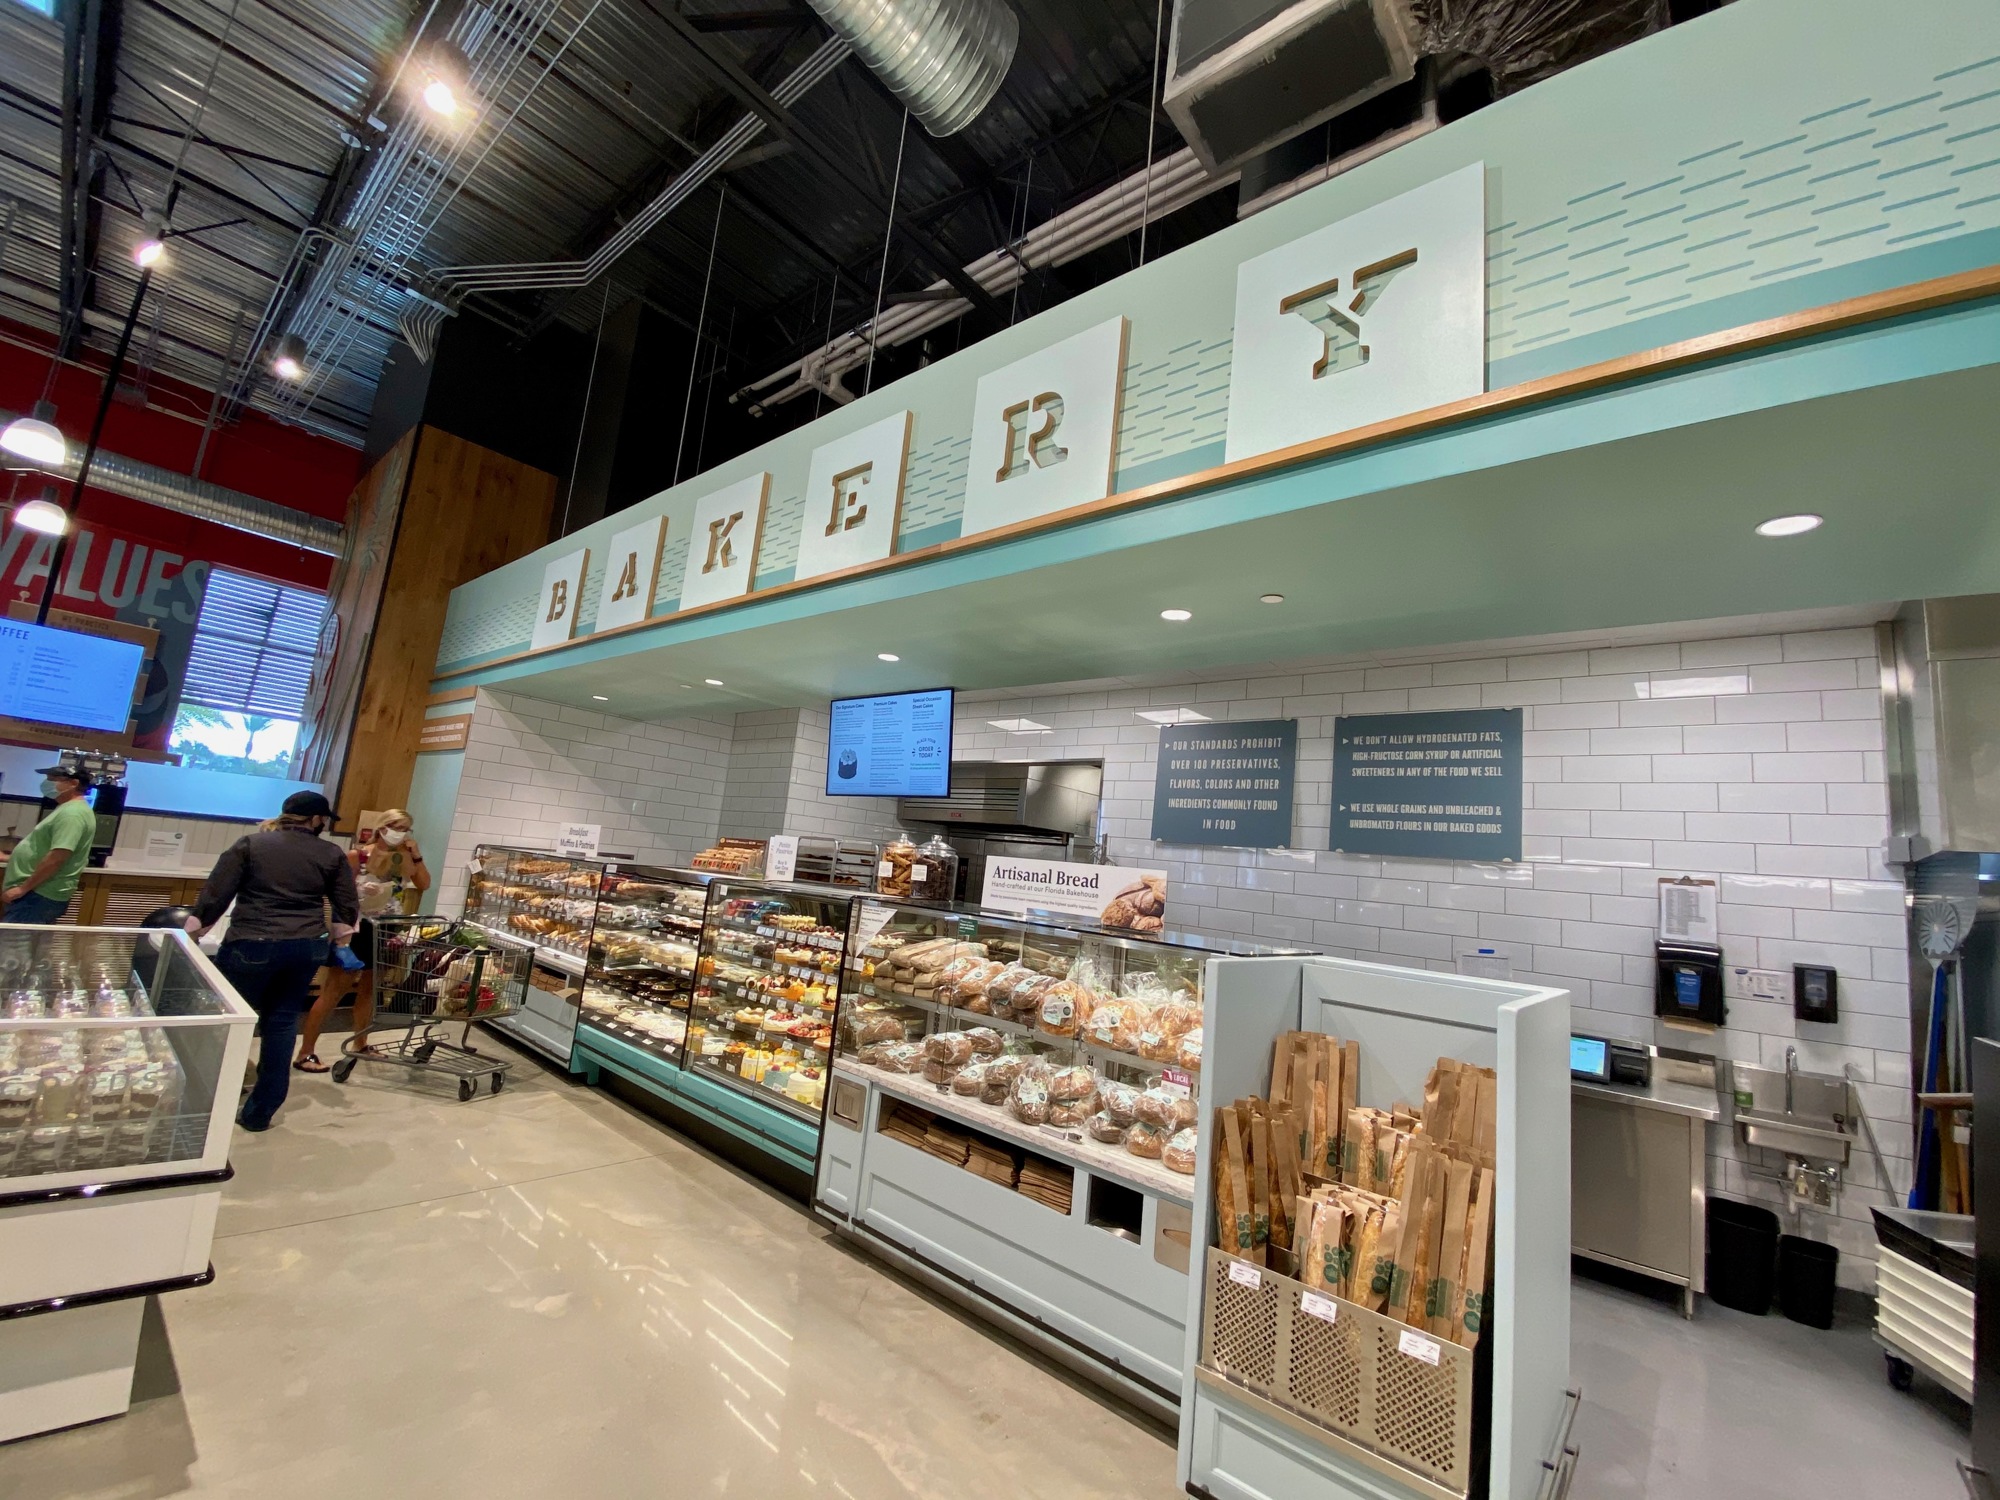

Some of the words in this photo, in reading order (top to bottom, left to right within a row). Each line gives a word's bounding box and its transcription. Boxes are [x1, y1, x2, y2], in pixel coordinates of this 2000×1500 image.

[1173, 741, 1187, 750] OUR
[1190, 740, 1238, 750] STANDARDS
[1241, 738, 1282, 749] PROHIBIT
[1353, 736, 1364, 745] WE
[1365, 735, 1387, 745] DON'T
[1389, 735, 1413, 744] ALLOW
[1416, 733, 1477, 743] HYDROGENATED
[1480, 732, 1503, 743] FATS,
[1352, 751, 1404, 761] HIGH-FRUCTOSE
[1405, 751, 1424, 760] CORN
[1425, 750, 1449, 760] SYRUP
[1450, 750, 1460, 759] OR
[1462, 749, 1503, 759] ARTIFICIAL
[1170, 760, 1190, 769] OVER
[1193, 760, 1207, 769] 100
[1210, 759, 1281, 770] PRESERVATIVES,
[1352, 768, 1395, 777] SWEETENERS
[1396, 767, 1405, 776] IN
[1406, 767, 1421, 776] ANY
[1423, 767, 1432, 776] OF
[1434, 767, 1447, 776] THE
[1449, 767, 1468, 776] FOOD
[1470, 767, 1482, 776] WE
[1484, 766, 1503, 776] SELL
[1169, 779, 1203, 790] FLAVORS,
[1205, 779, 1233, 789] COLORS
[1235, 779, 1251, 789] AND
[1254, 779, 1279, 790] OTHER
[1168, 798, 1211, 809] INGREDIENTS
[1212, 799, 1251, 810] COMMONLY
[1253, 800, 1278, 811] FOUND
[1350, 803, 1360, 813] WE
[1362, 803, 1374, 813] USE
[1376, 804, 1399, 813] WHOLE
[1400, 804, 1427, 814] GRAINS
[1428, 805, 1444, 815] AND
[1445, 805, 1493, 815] UNBLEACHED
[1495, 806, 1502, 815] &
[1202, 819, 1212, 829] IN
[1215, 819, 1236, 830] FOOD
[1349, 819, 1394, 830] UNBROMATED
[1396, 821, 1422, 831] FLOURS
[1424, 822, 1432, 831] IN
[1433, 822, 1448, 832] OUR
[1449, 822, 1474, 833] BAKED
[1476, 823, 1502, 834] GOODS
[560, 838, 575, 848] Muffins
[579, 840, 595, 850] Pastries
[992, 865, 1052, 884] Artisanal
[1056, 871, 1099, 889] Bread
[991, 881, 1026, 891] Hand-crafted
[1045, 887, 1065, 895] Florida
[1066, 889, 1099, 898] Bakehouse
